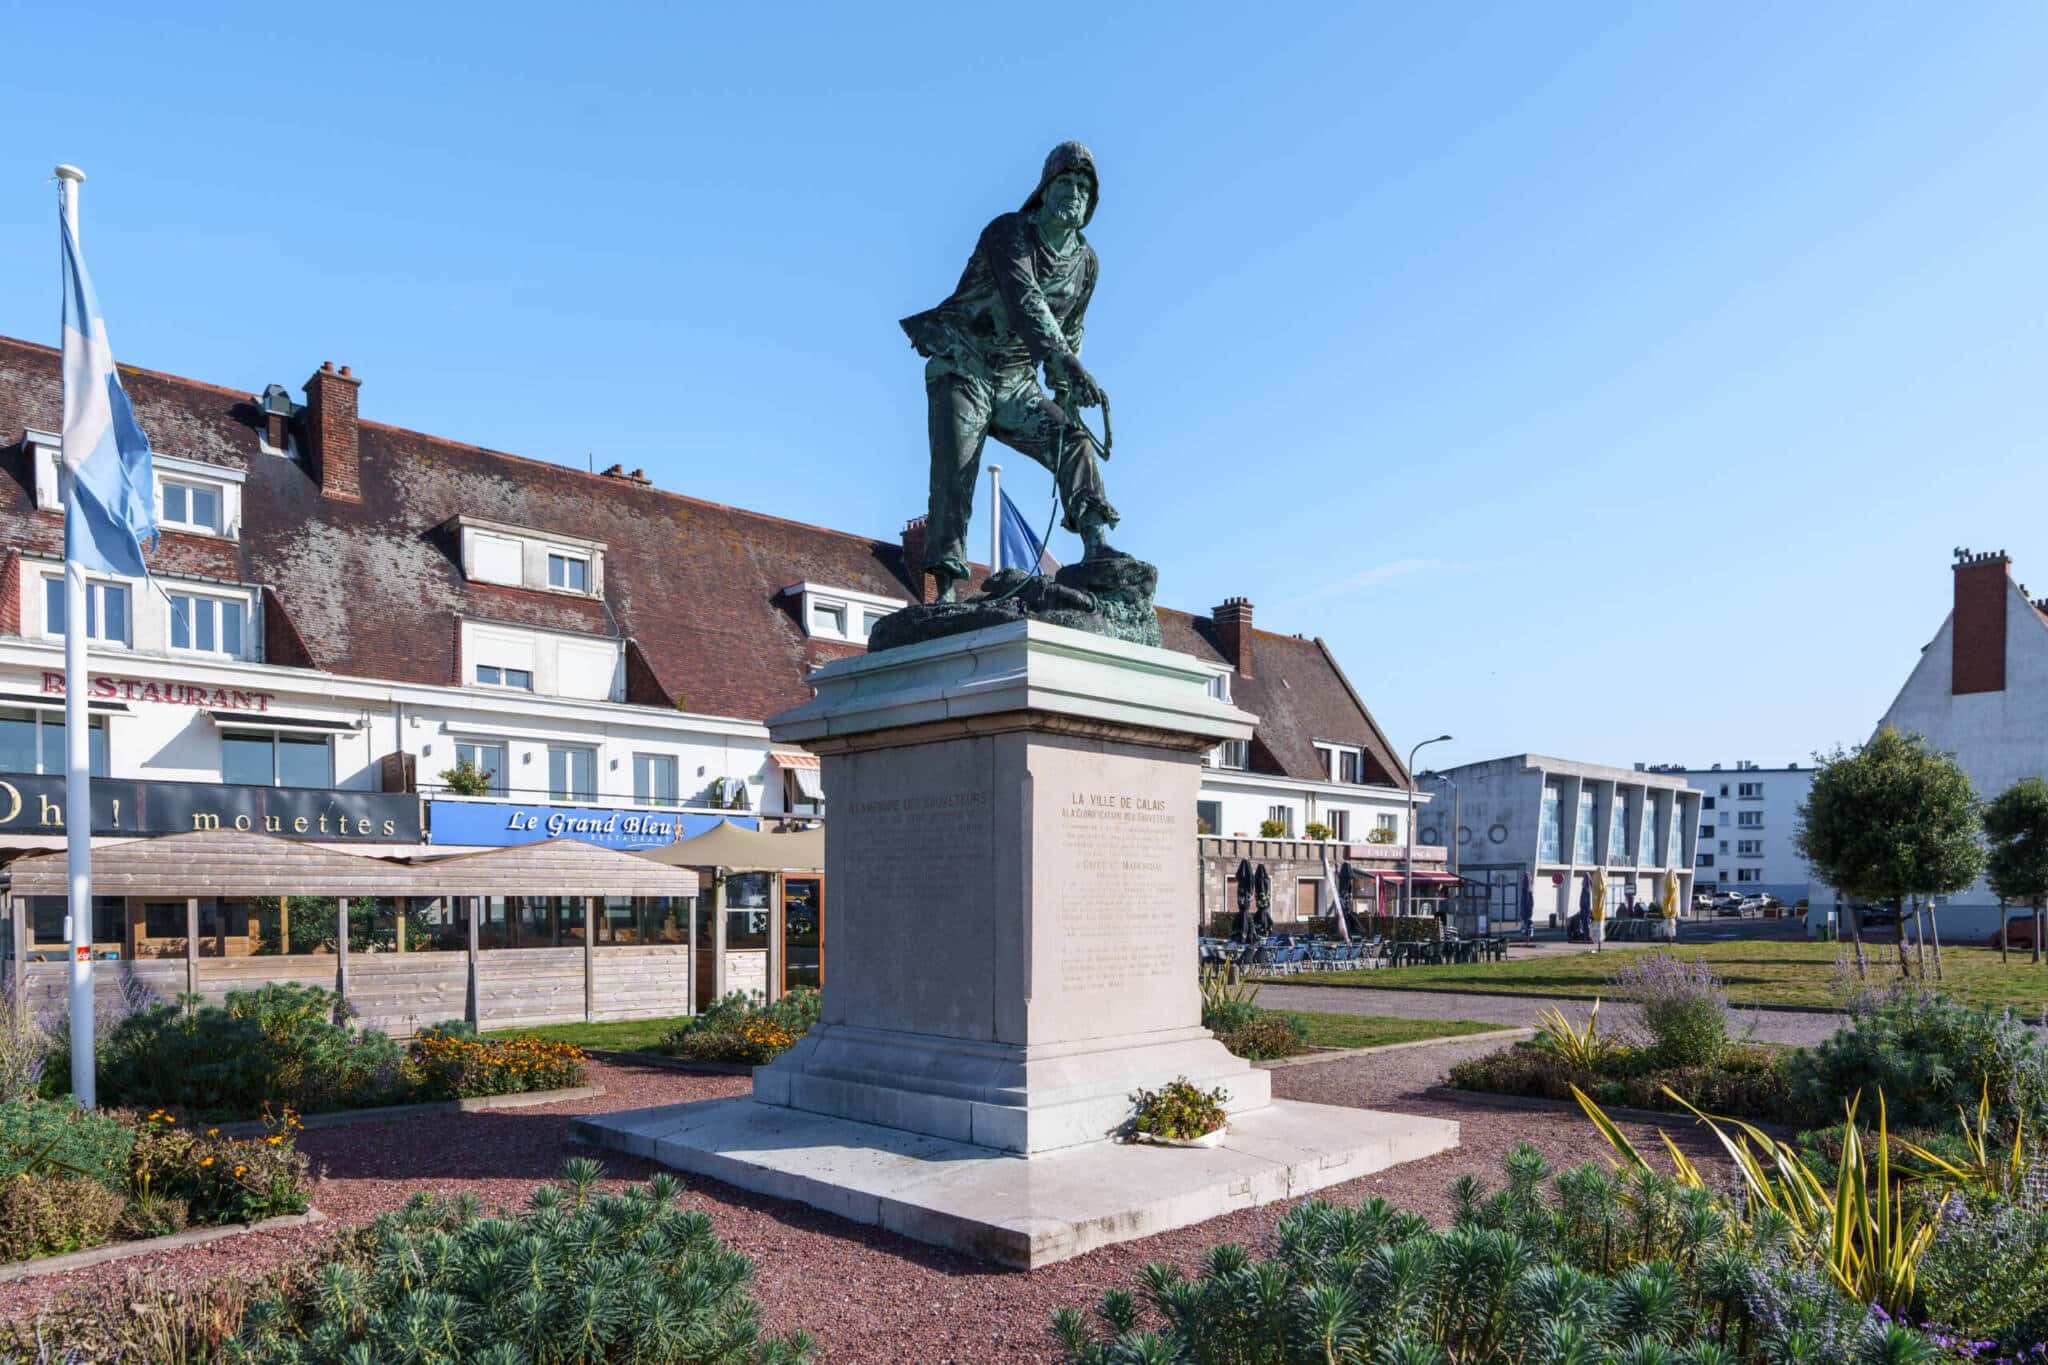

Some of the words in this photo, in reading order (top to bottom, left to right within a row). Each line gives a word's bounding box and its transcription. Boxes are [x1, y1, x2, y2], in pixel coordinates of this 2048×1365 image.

[42, 671, 275, 712] RSTAURANT
[1072, 792, 1085, 806] LA
[1090, 794, 1116, 808] VILLE
[1120, 797, 1132, 809] DE
[1137, 799, 1166, 812] CALAIS
[191, 812, 396, 836] mouettes
[507, 810, 539, 831] Le
[548, 812, 620, 837] Grand
[622, 815, 671, 835] Bleu
